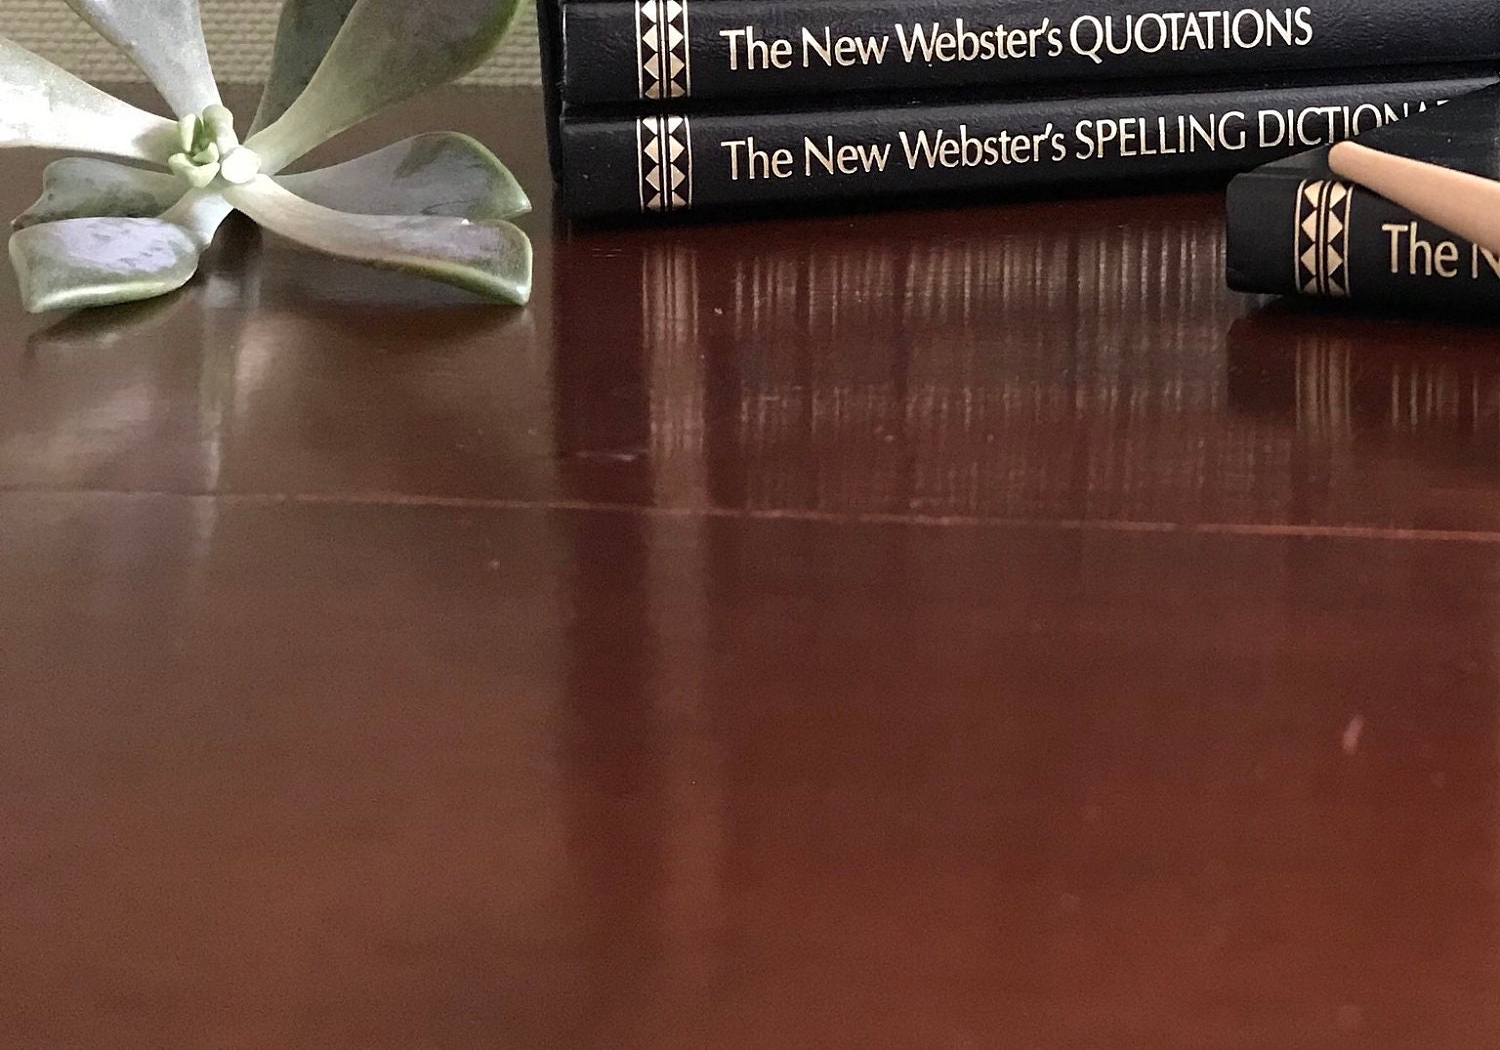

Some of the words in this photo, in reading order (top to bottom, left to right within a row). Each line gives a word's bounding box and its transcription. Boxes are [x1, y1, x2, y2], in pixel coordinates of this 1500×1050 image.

[718, 25, 793, 72] The
[801, 26, 890, 69] New
[894, 17, 1063, 65] Webster's
[1069, 6, 1313, 65] QUOTATIONS
[719, 136, 794, 182] The
[803, 135, 892, 178] New
[897, 123, 1067, 172] Webster's
[1075, 110, 1246, 161] SPELLING
[1256, 99, 1449, 148] DICTIO
[1381, 221, 1459, 279] The
